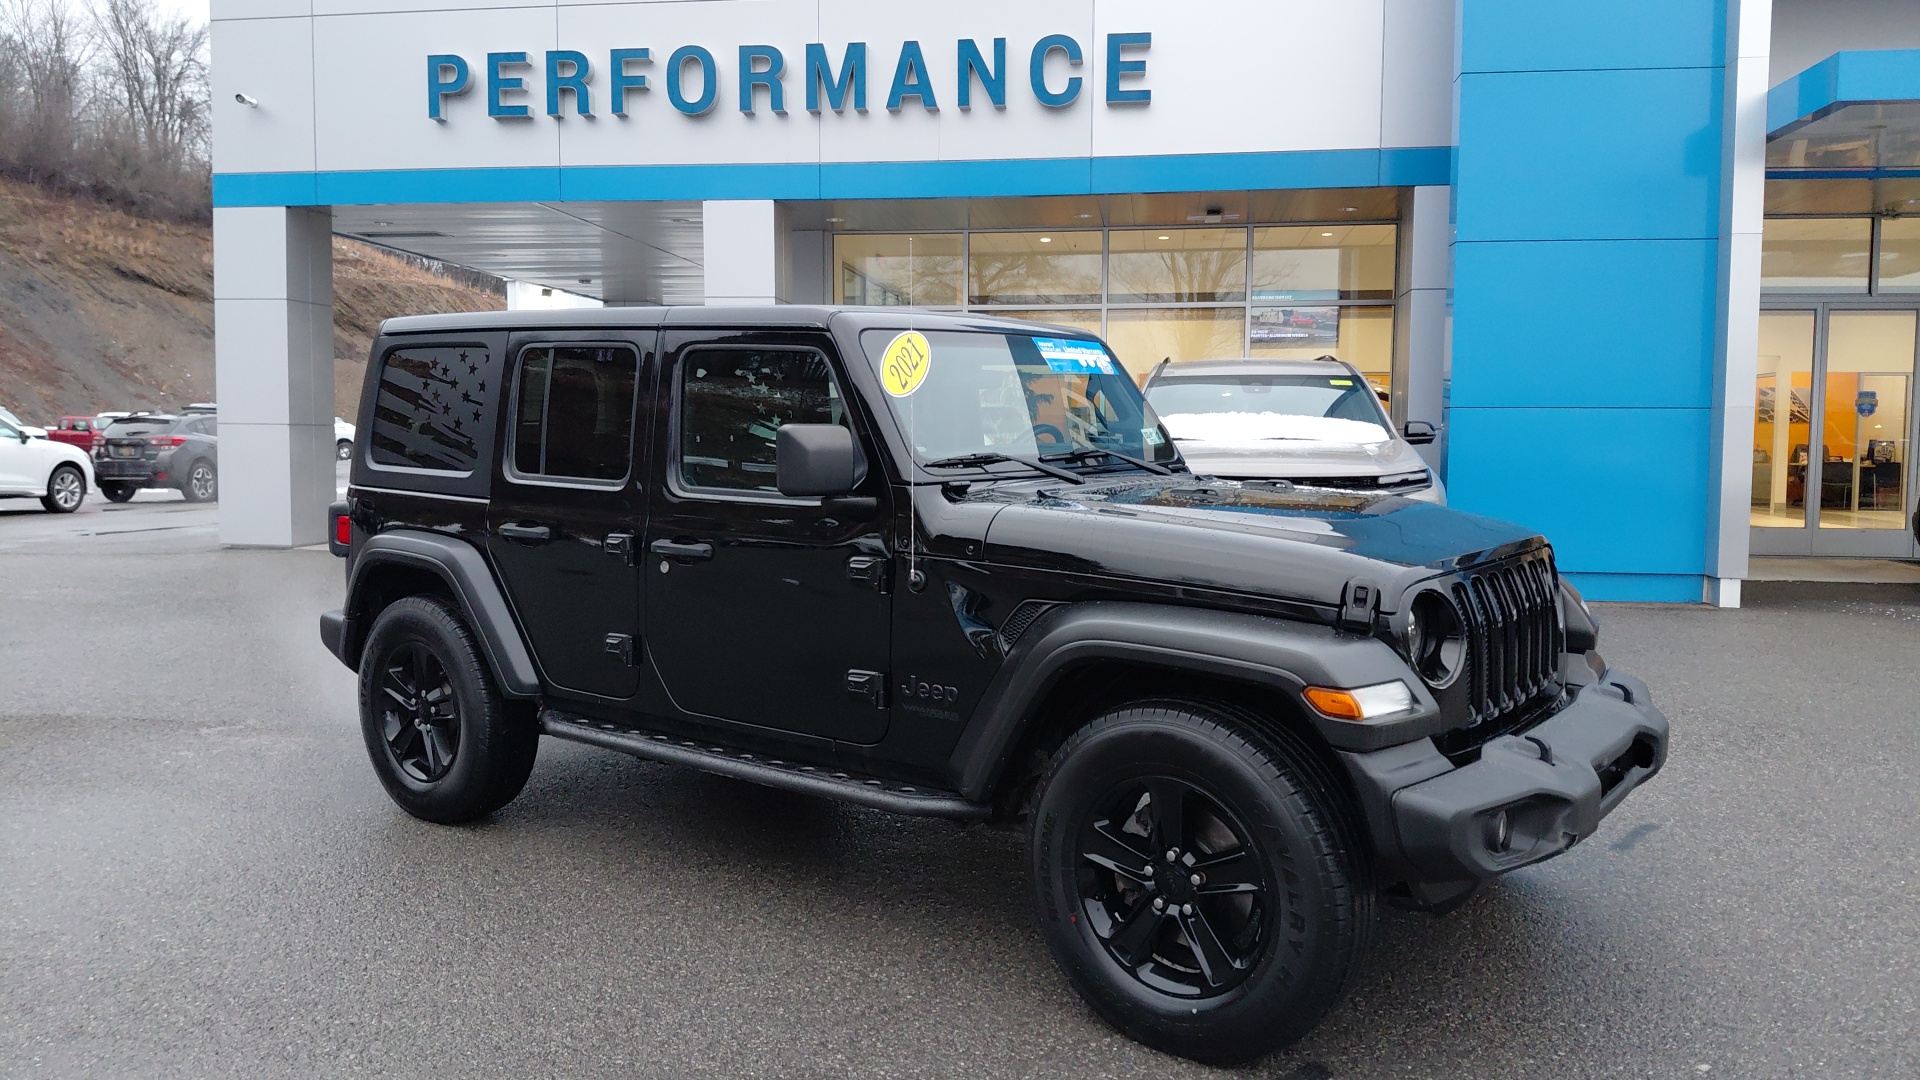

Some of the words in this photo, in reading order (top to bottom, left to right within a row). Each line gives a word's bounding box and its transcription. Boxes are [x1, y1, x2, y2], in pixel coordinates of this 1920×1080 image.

[427, 32, 1152, 121] PERFORMANCE
[889, 337, 924, 390] 2021
[901, 675, 959, 707] Jeep
